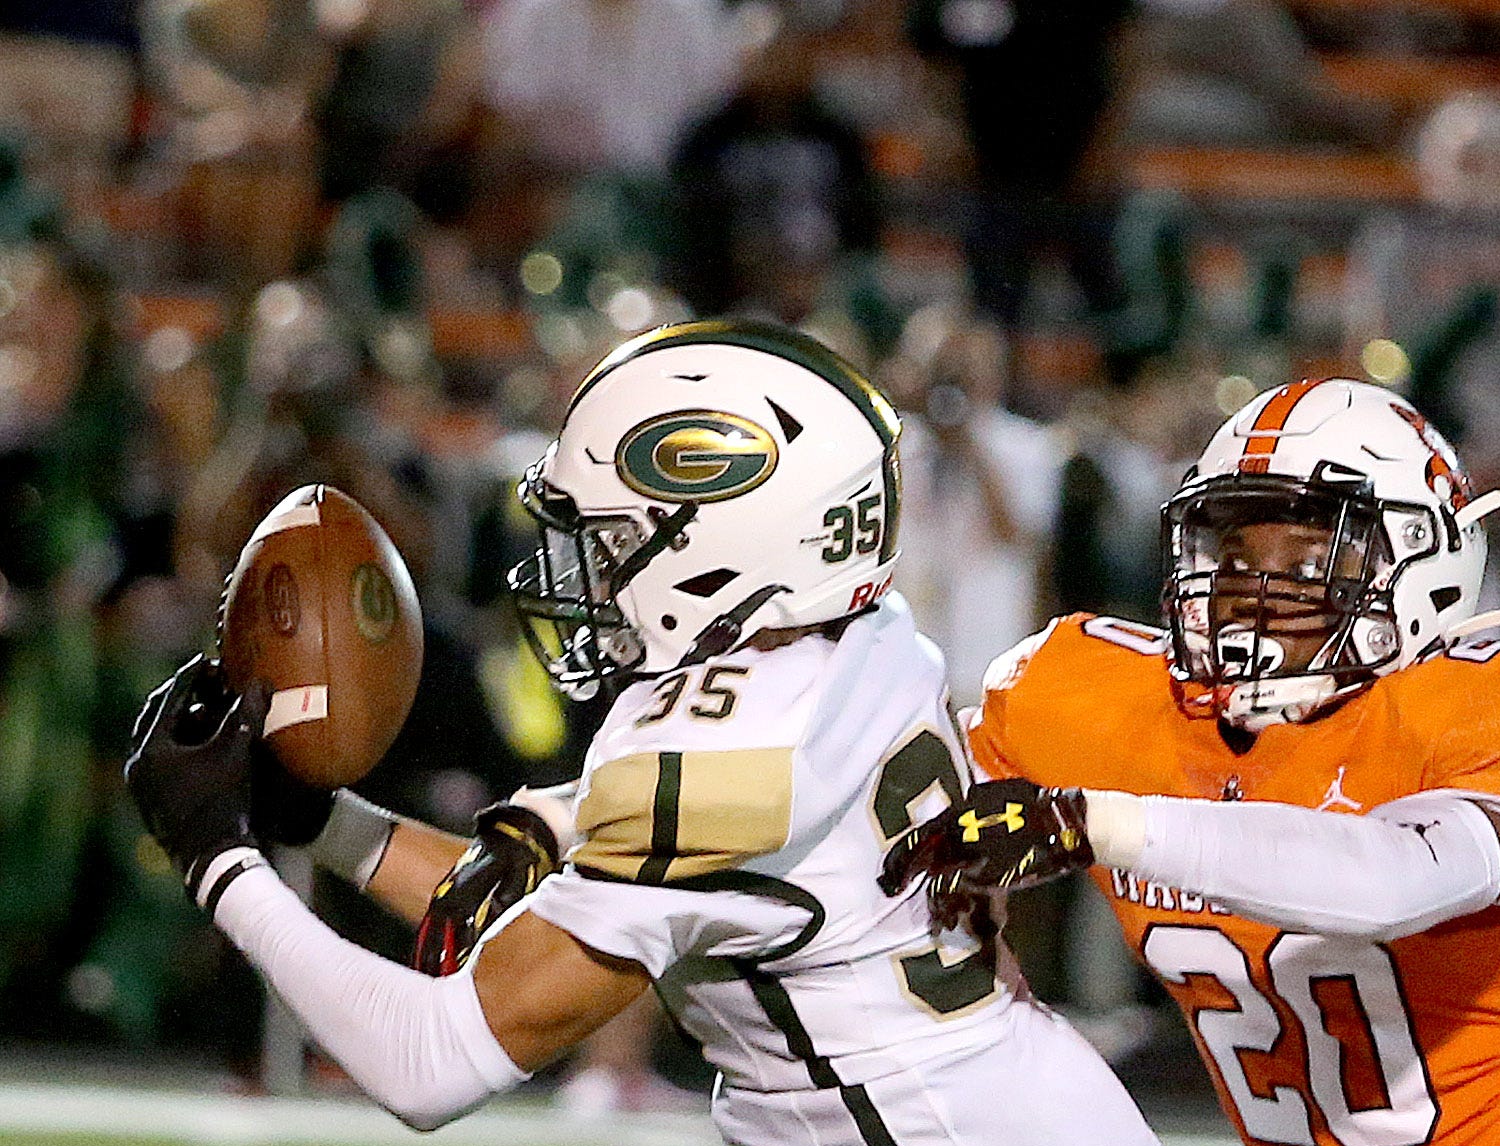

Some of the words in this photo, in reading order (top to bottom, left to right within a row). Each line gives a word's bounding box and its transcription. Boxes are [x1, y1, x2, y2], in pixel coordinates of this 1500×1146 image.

[616, 408, 780, 504] G
[821, 493, 882, 563] 35
[634, 665, 751, 730] 35
